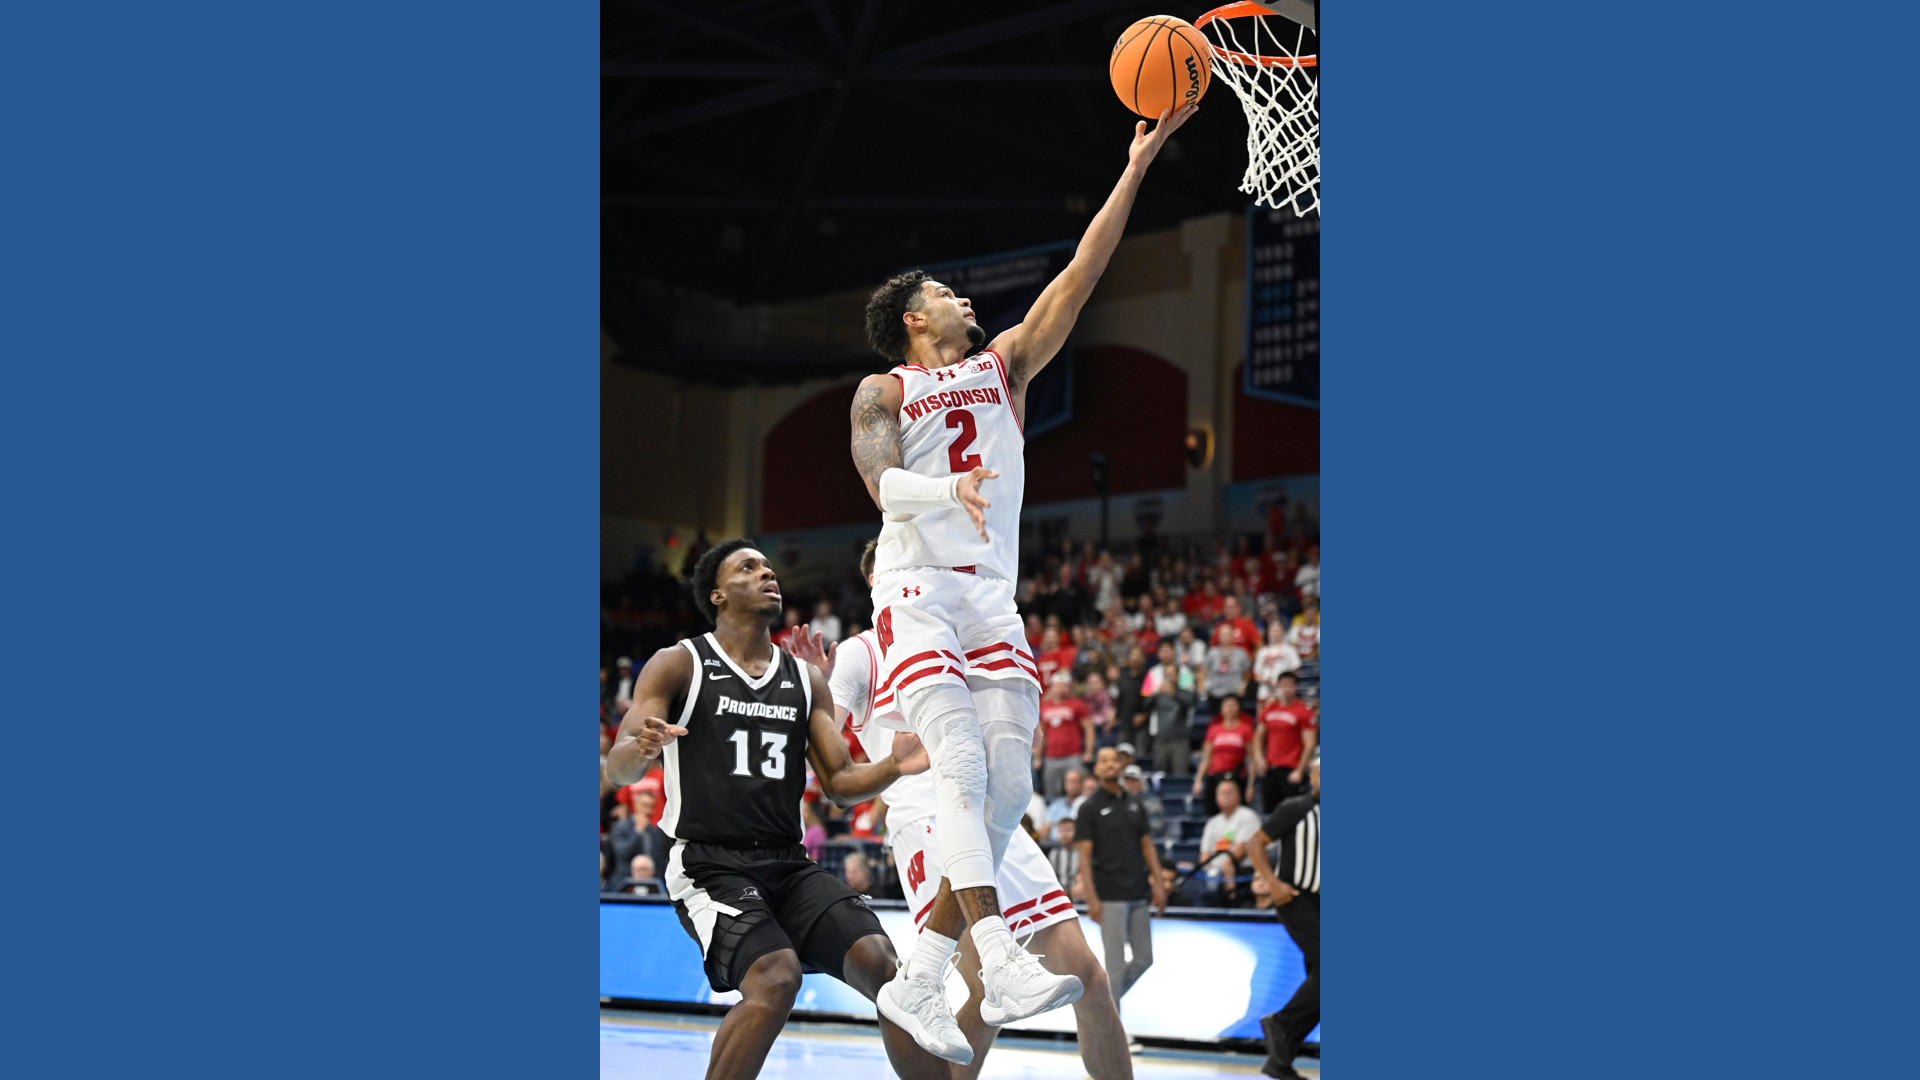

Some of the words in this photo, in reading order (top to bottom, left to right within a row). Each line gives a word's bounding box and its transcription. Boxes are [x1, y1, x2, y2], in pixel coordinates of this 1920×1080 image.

[1185, 54, 1200, 106] ilson
[903, 387, 1002, 421] WISCONSIN
[945, 408, 983, 473] 2
[714, 695, 798, 721] PROVIDENCE
[726, 728, 788, 780] 13
